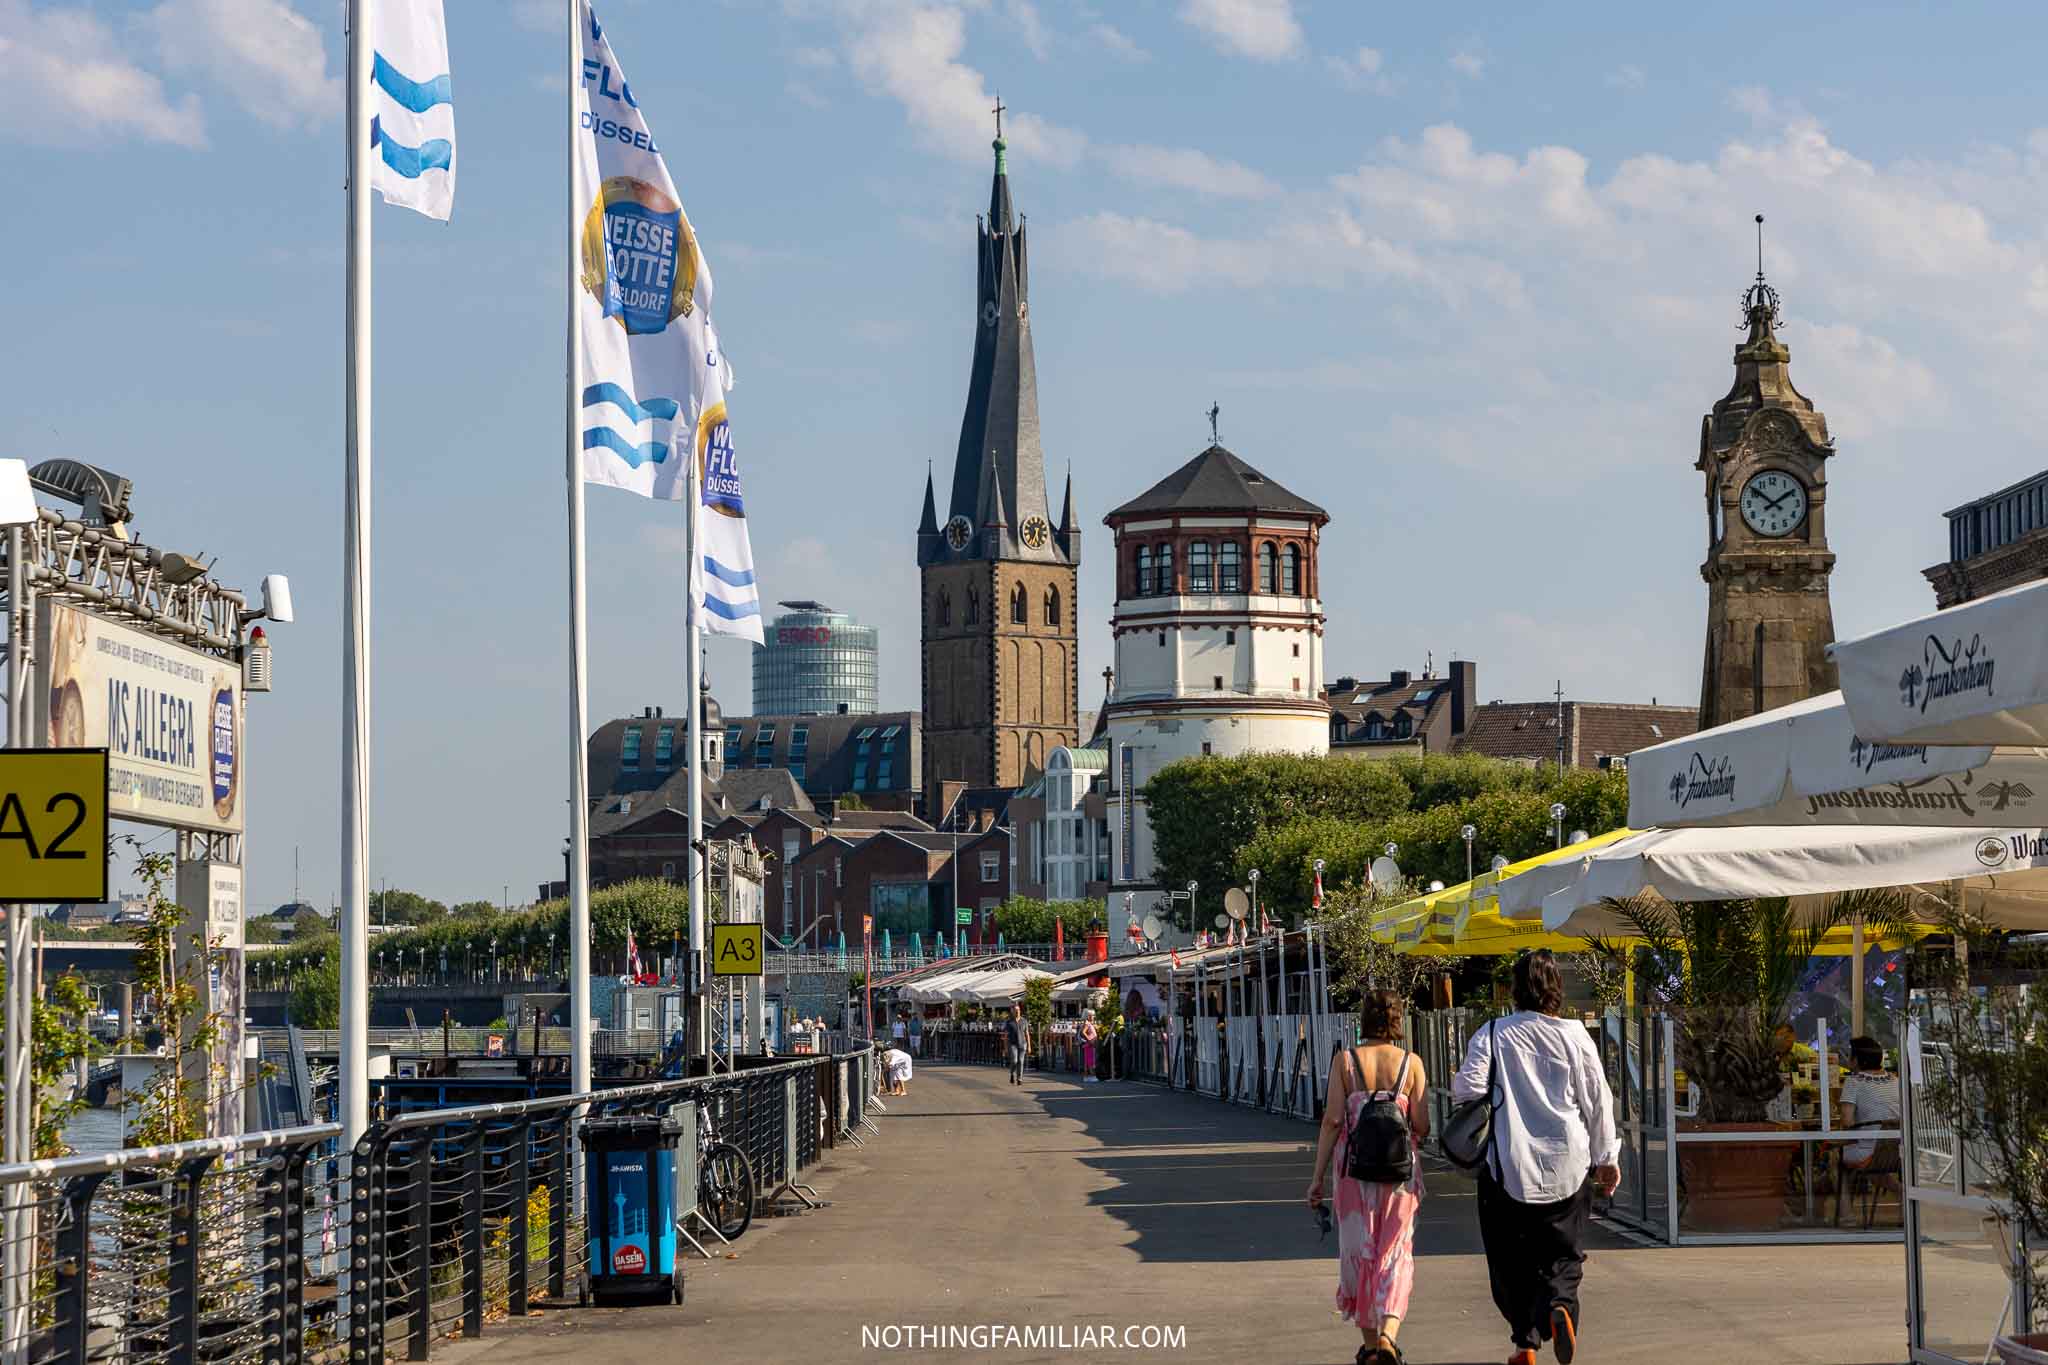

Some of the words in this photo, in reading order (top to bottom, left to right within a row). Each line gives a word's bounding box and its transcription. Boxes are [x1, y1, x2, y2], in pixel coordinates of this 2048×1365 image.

[108, 678, 130, 754] MS
[134, 685, 195, 769] ALLEGRA
[0, 793, 87, 859] A2
[720, 938, 756, 961] A3
